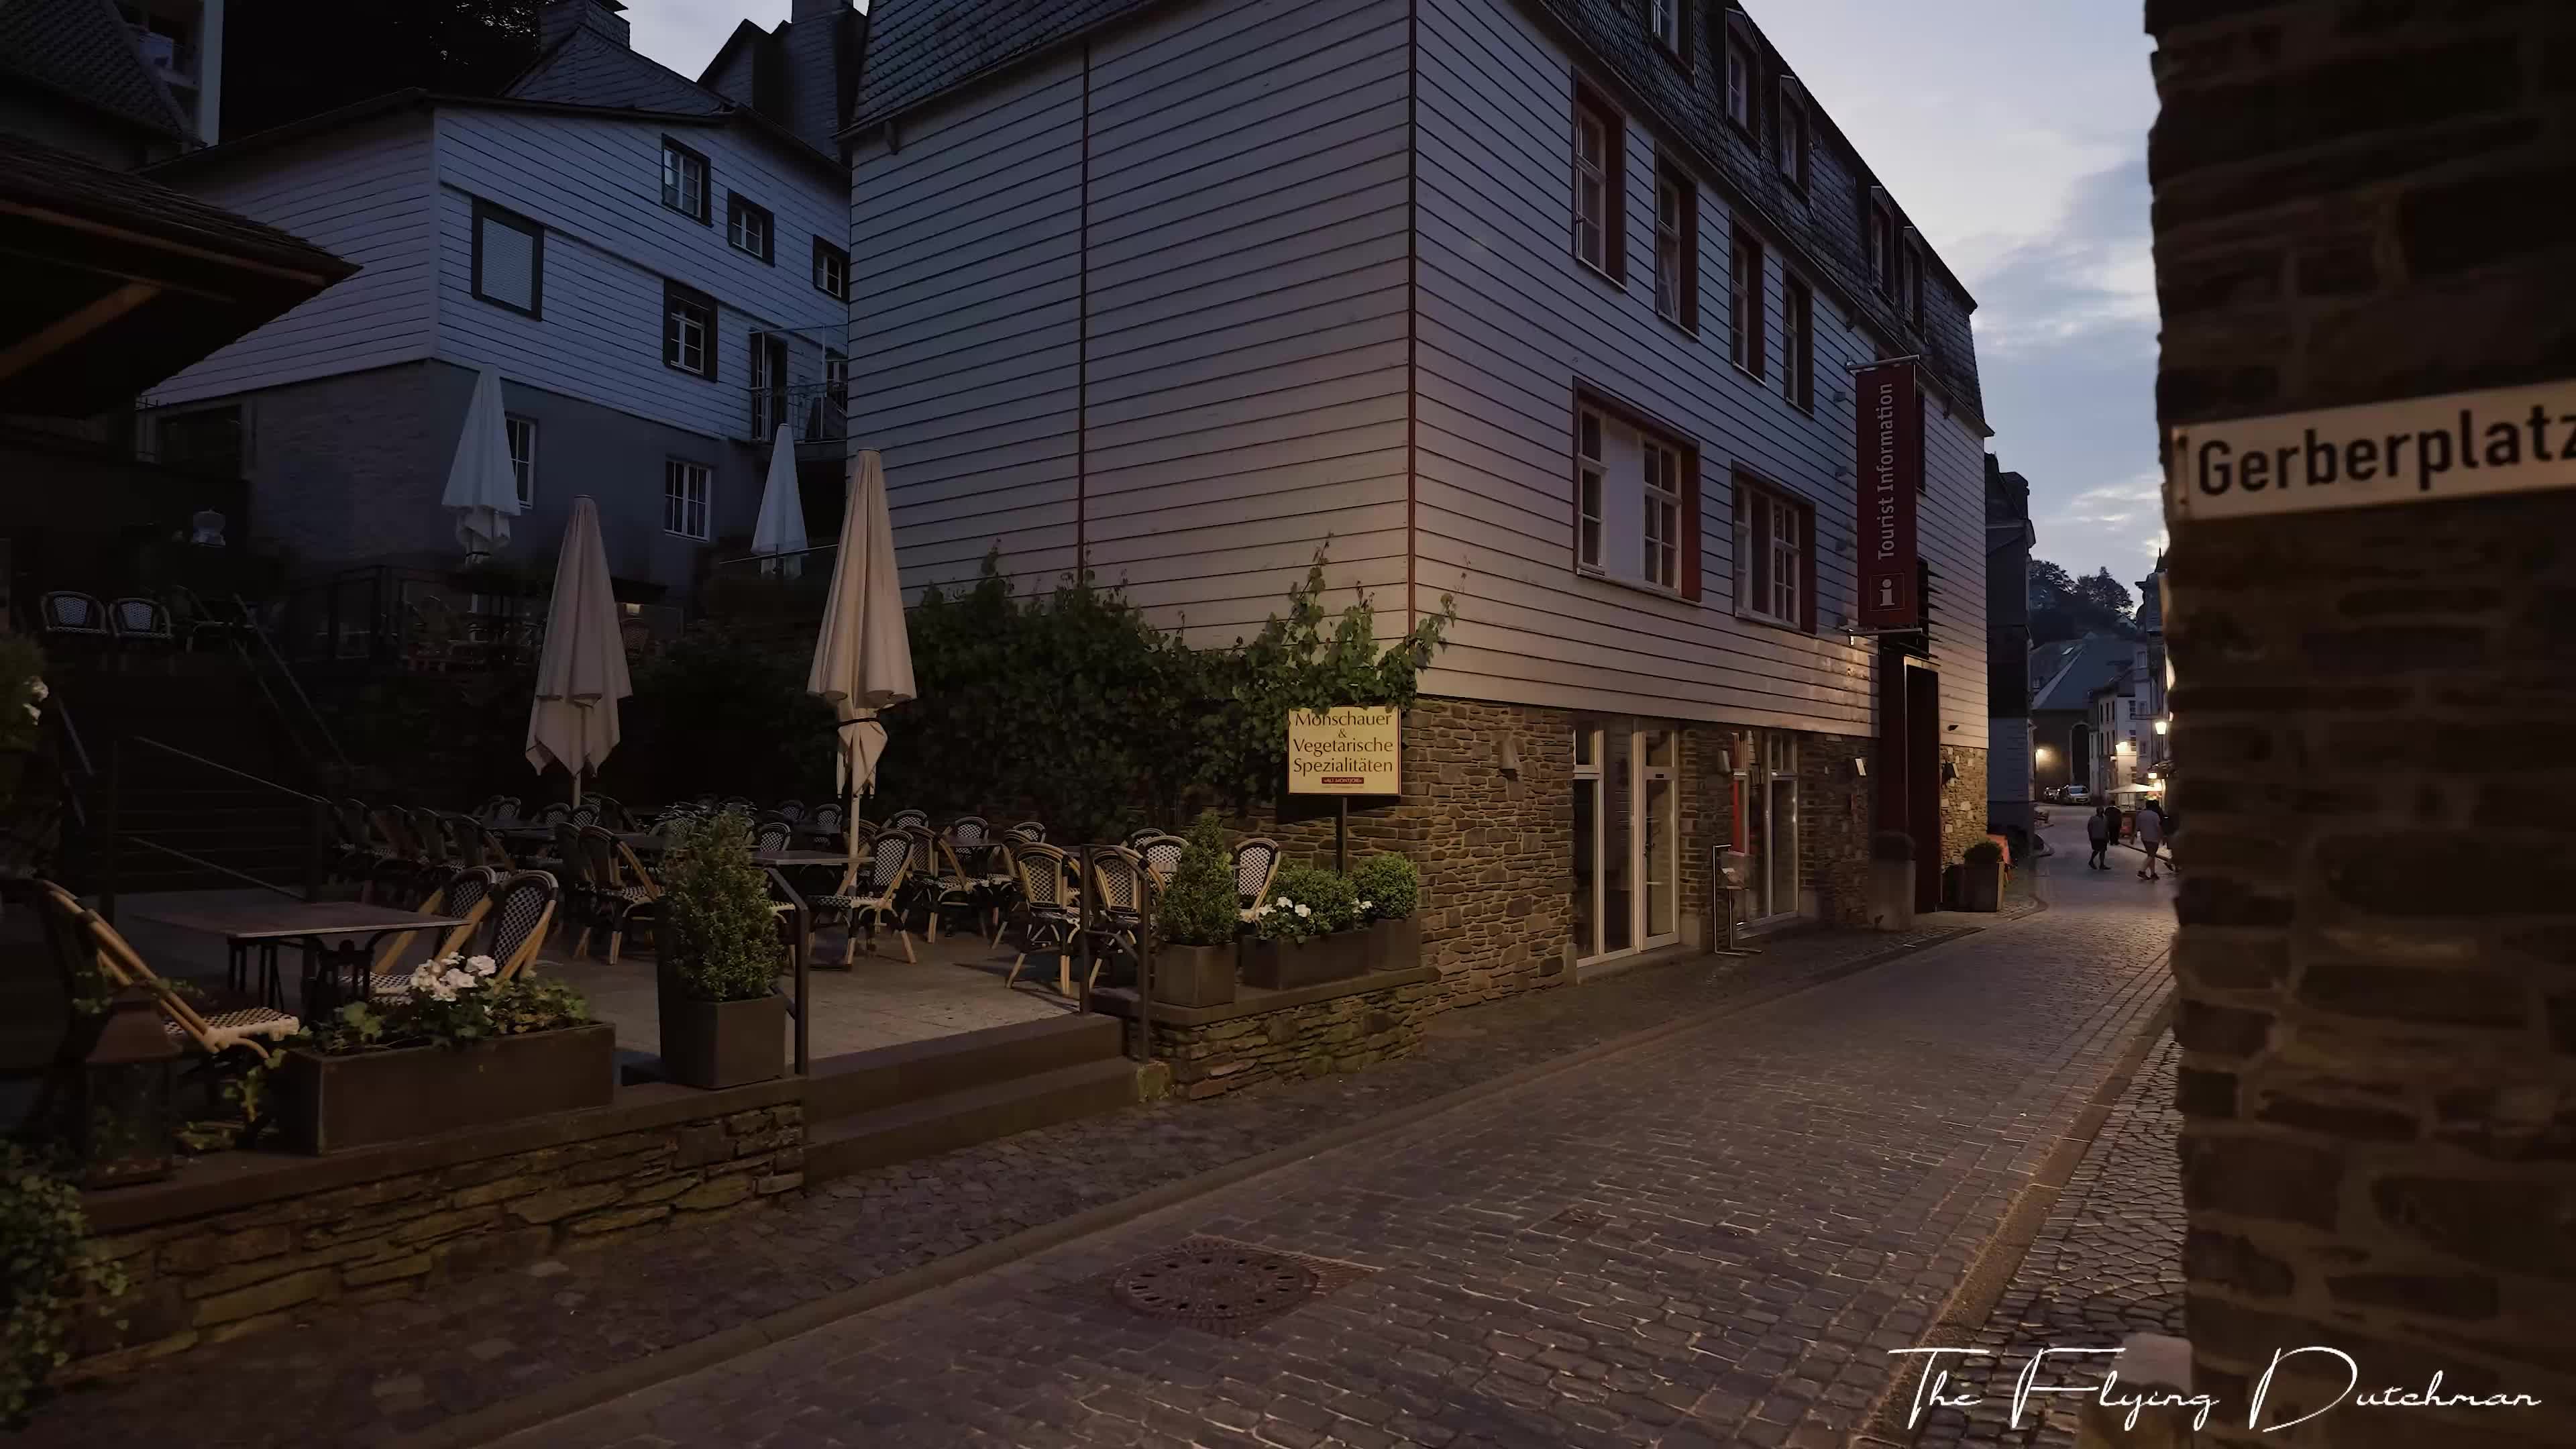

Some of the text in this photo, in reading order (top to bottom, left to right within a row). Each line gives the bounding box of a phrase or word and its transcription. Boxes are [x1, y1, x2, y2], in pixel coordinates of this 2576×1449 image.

[1875, 382, 1895, 561] Tourist Information
[1295, 710, 1392, 727] Monschauer
[1338, 728, 1347, 739] &
[1293, 737, 1393, 757] Vegetarische
[1293, 757, 1393, 777] Spezialitäten
